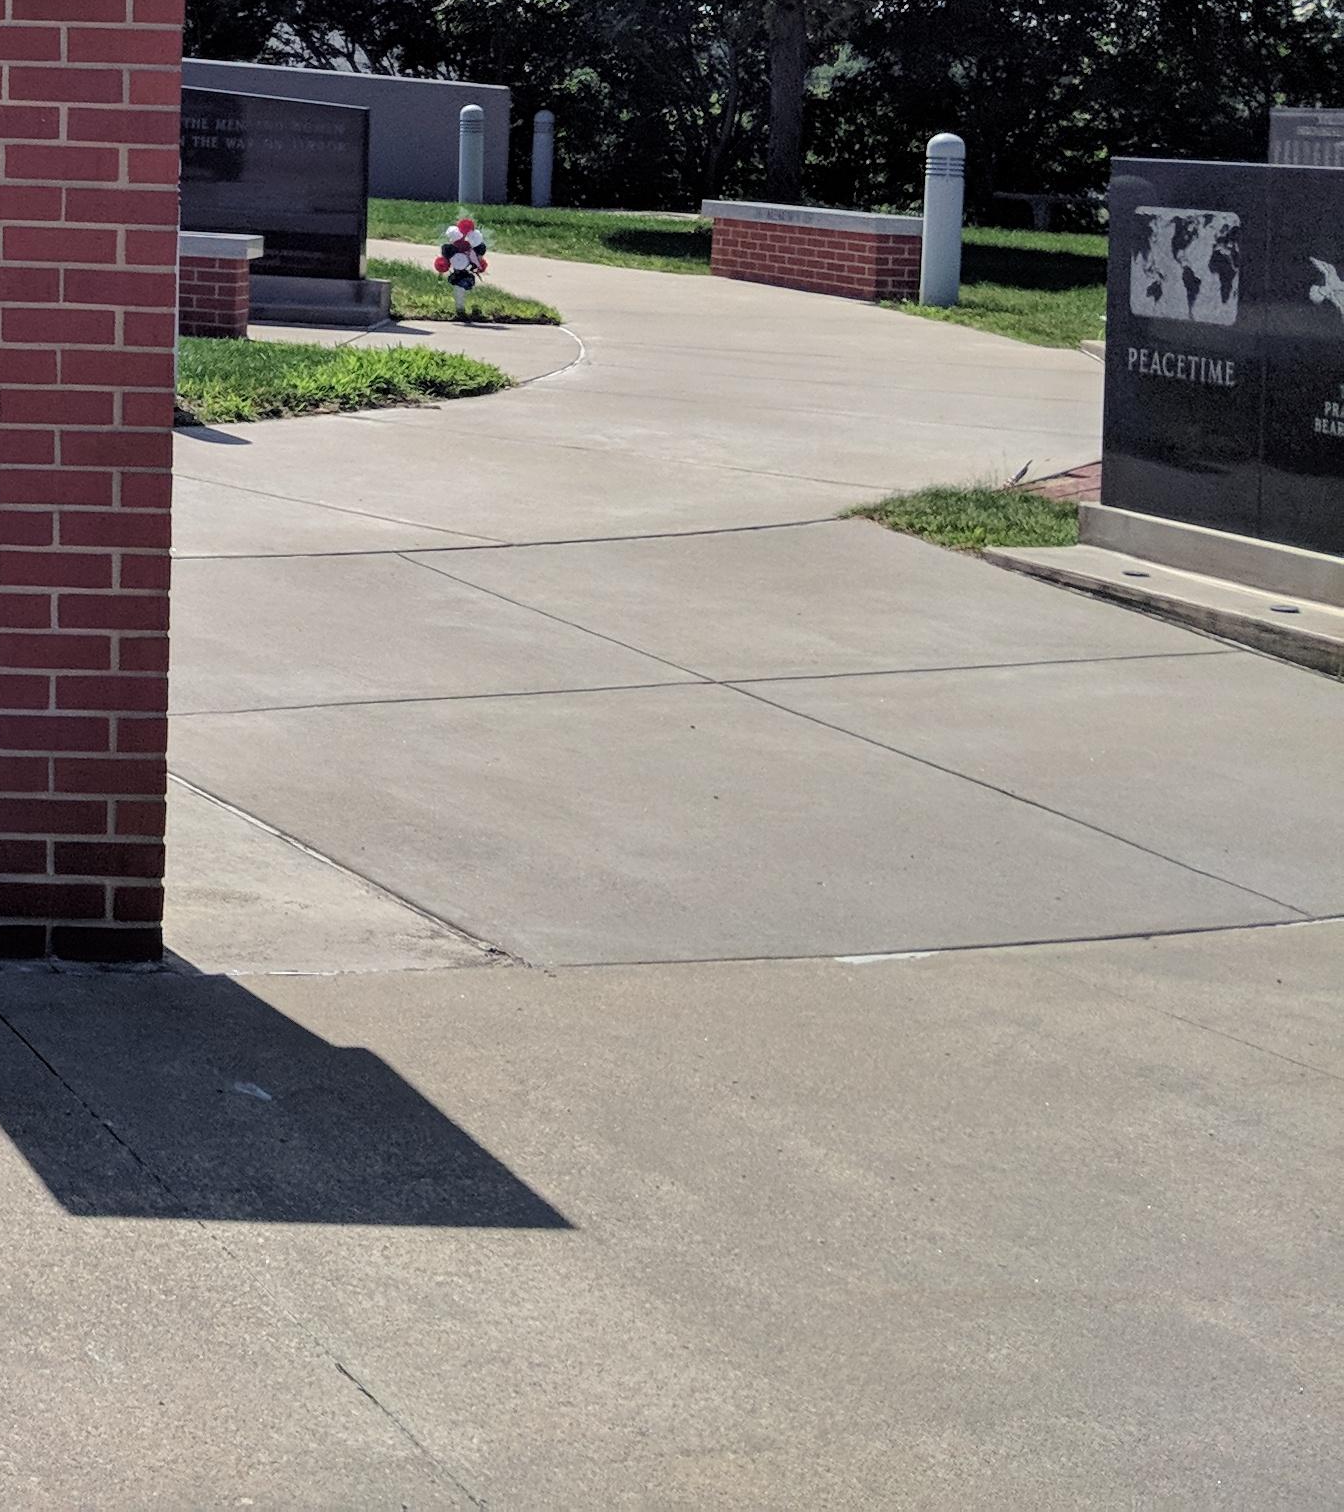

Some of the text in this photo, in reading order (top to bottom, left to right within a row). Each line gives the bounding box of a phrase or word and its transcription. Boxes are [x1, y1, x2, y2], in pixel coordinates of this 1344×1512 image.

[182, 118, 209, 130] THE
[192, 136, 218, 149] THE
[1127, 348, 1235, 387] PEACETIME
